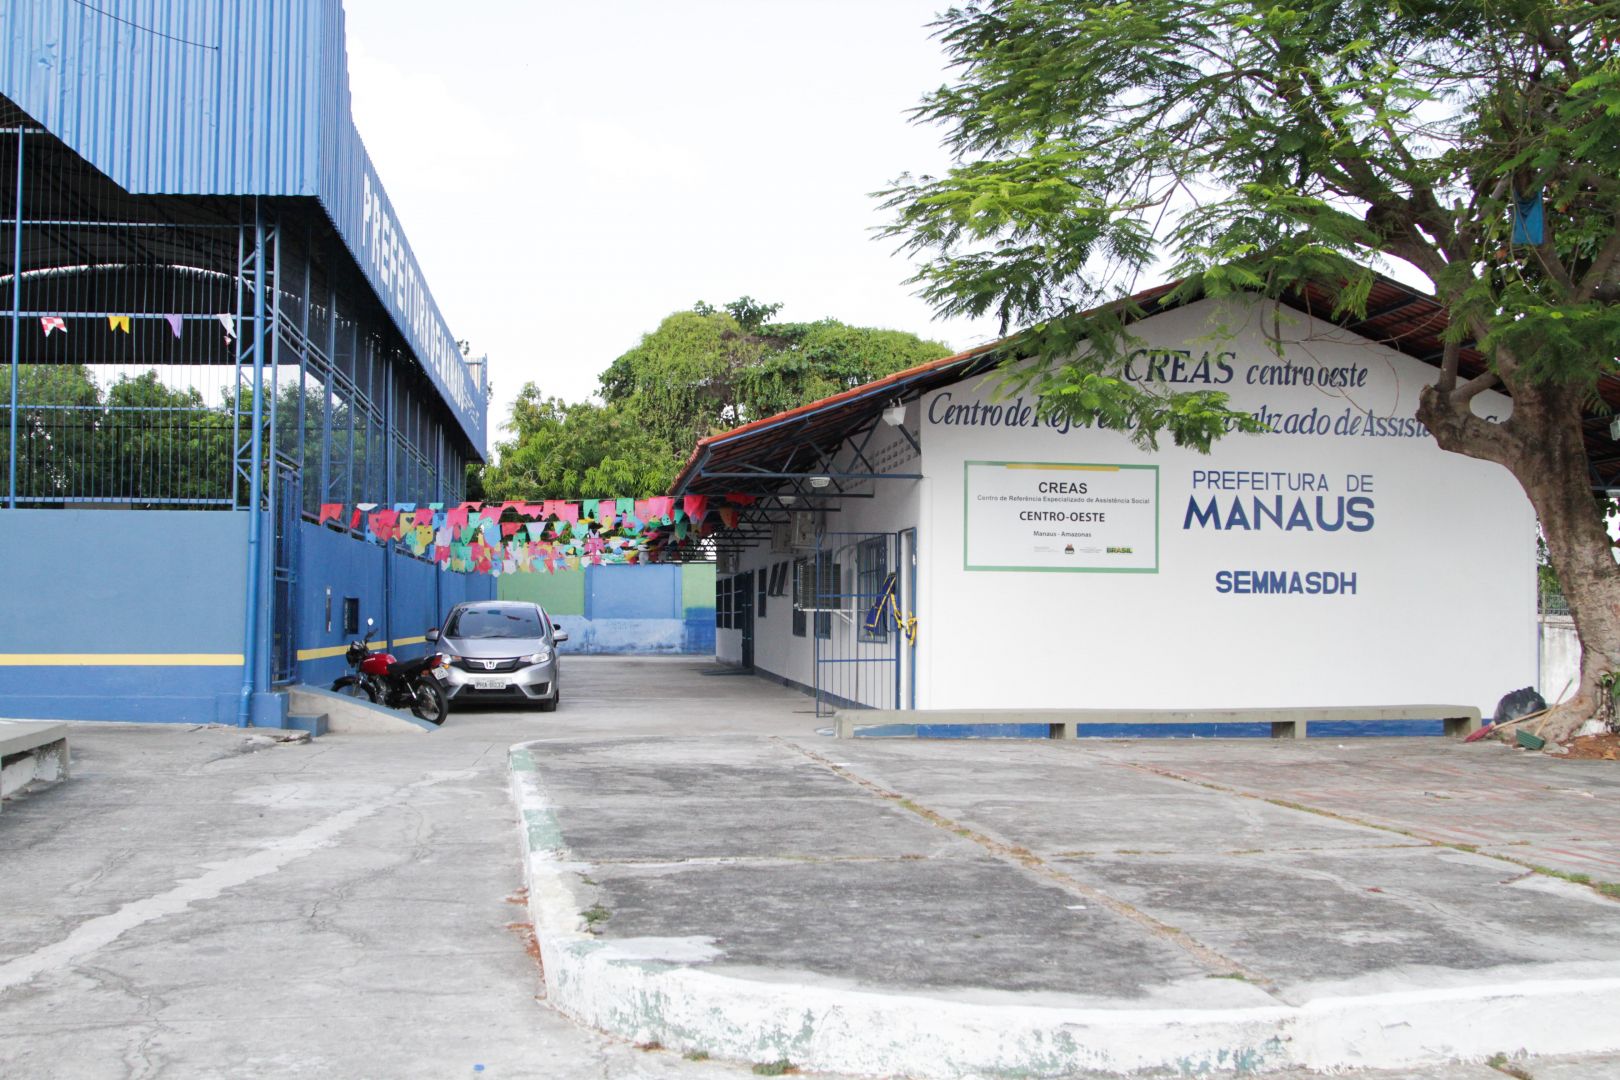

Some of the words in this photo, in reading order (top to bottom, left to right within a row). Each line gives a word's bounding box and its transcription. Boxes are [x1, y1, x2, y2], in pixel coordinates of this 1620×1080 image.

[362, 173, 429, 357] PREFEITURA
[1124, 348, 1236, 384] CREAS
[1246, 359, 1315, 386] centro
[1317, 362, 1368, 387] oeste
[928, 392, 1003, 427] Centro
[1004, 397, 1032, 427] de
[1334, 408, 1362, 437] de
[1038, 482, 1088, 494] CREAS
[1193, 471, 1329, 492] PREFEITURA
[1346, 475, 1373, 492] DE
[1019, 511, 1106, 522] CENTRO-OESTE
[1183, 495, 1375, 532] MANAUS
[1215, 571, 1357, 594] SEMMASDH
